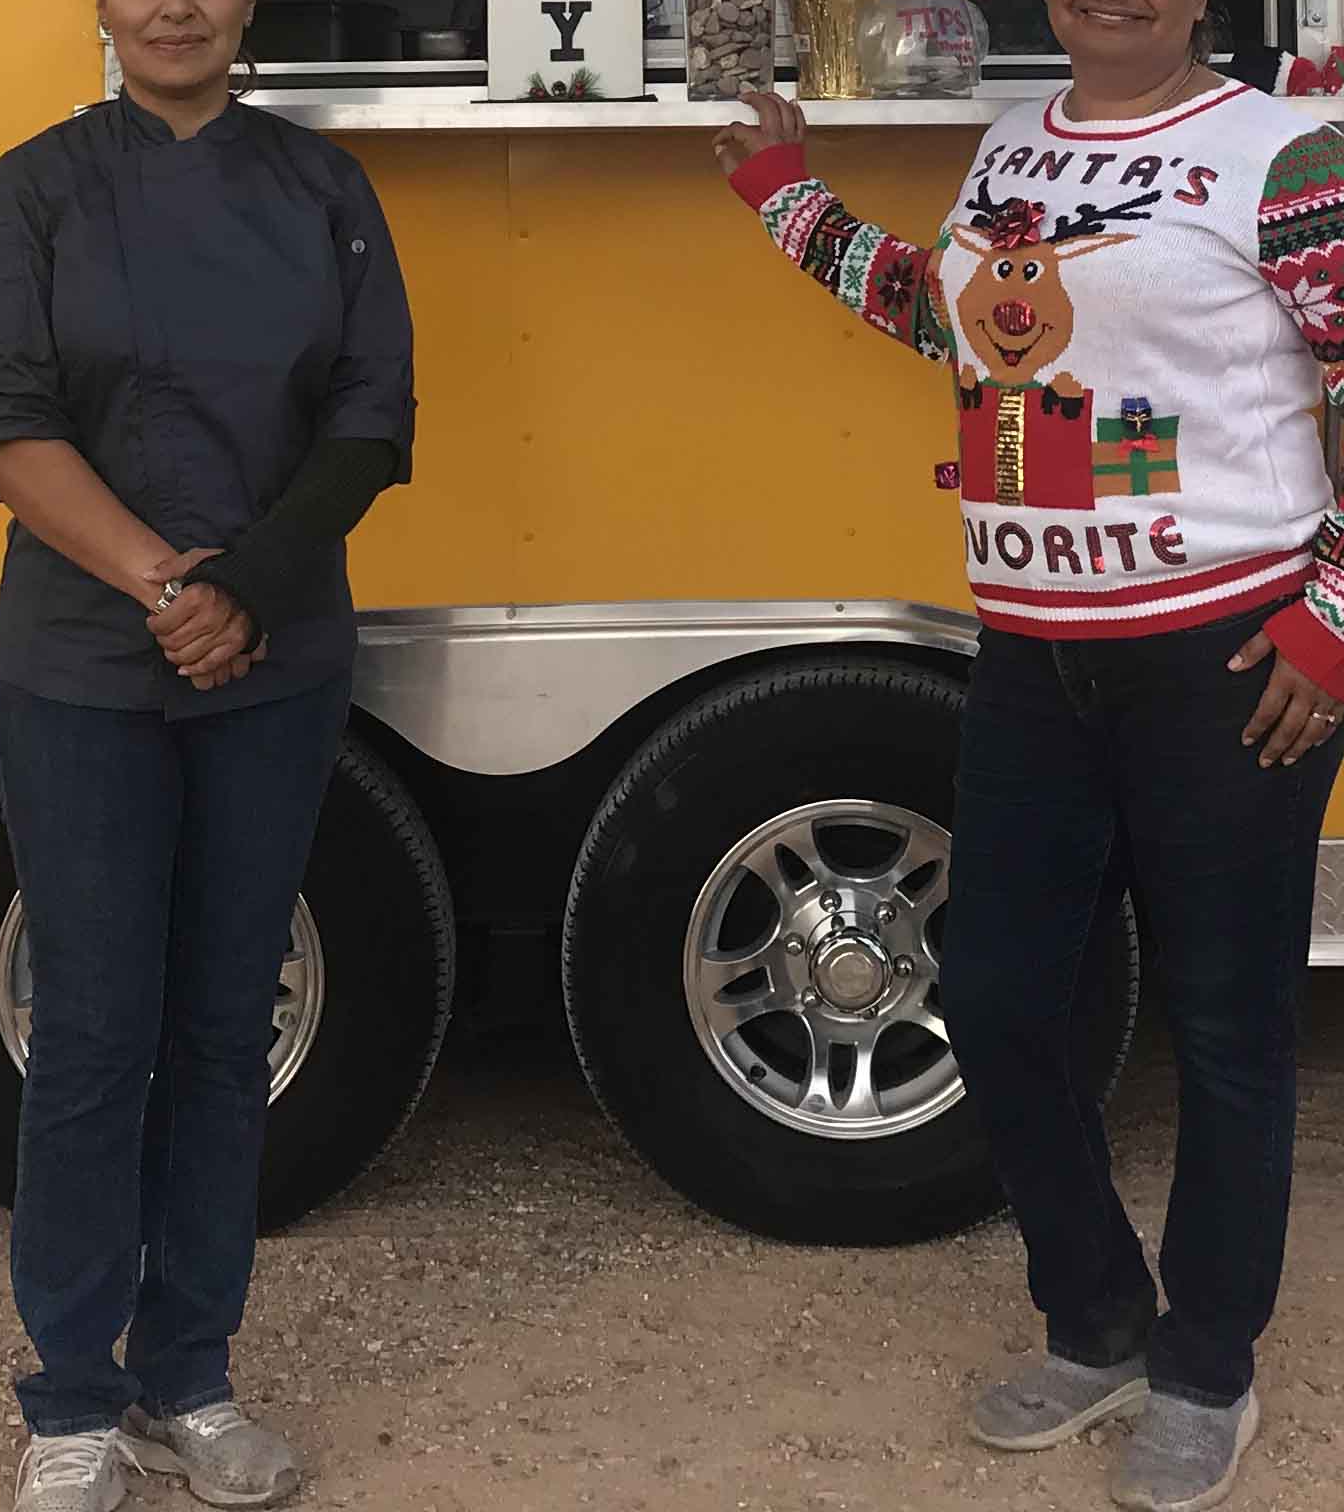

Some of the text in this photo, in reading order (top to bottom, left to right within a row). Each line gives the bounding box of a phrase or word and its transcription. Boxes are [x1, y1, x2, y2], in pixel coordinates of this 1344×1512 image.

[896, 7, 967, 37] TIPS
[971, 144, 1218, 206] SANTA'S
[963, 514, 1187, 575] VORITE
